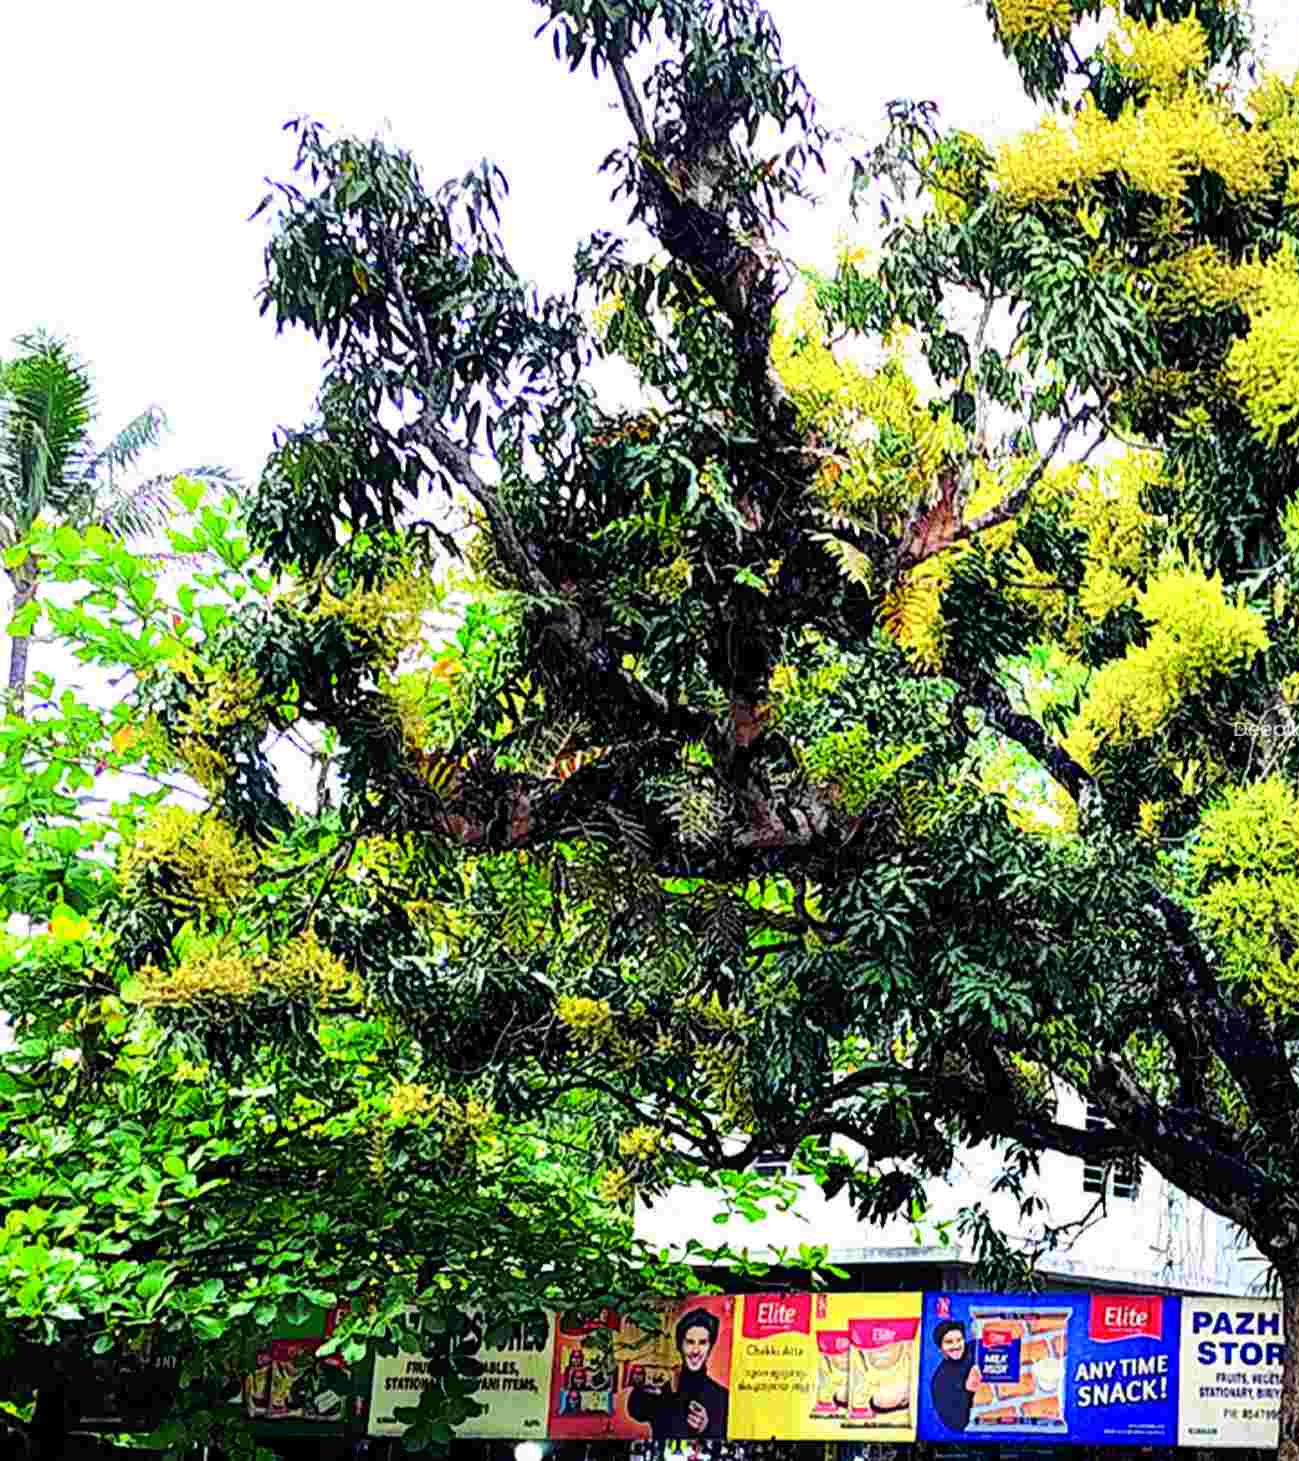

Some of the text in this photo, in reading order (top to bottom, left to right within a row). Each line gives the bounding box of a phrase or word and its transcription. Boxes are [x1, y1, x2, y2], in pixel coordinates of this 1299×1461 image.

[757, 1301, 797, 1325] Elite
[1104, 1305, 1149, 1328] Elite
[1075, 1354, 1169, 1382] ANY TIME
[1077, 1376, 1168, 1408] SNACK!
